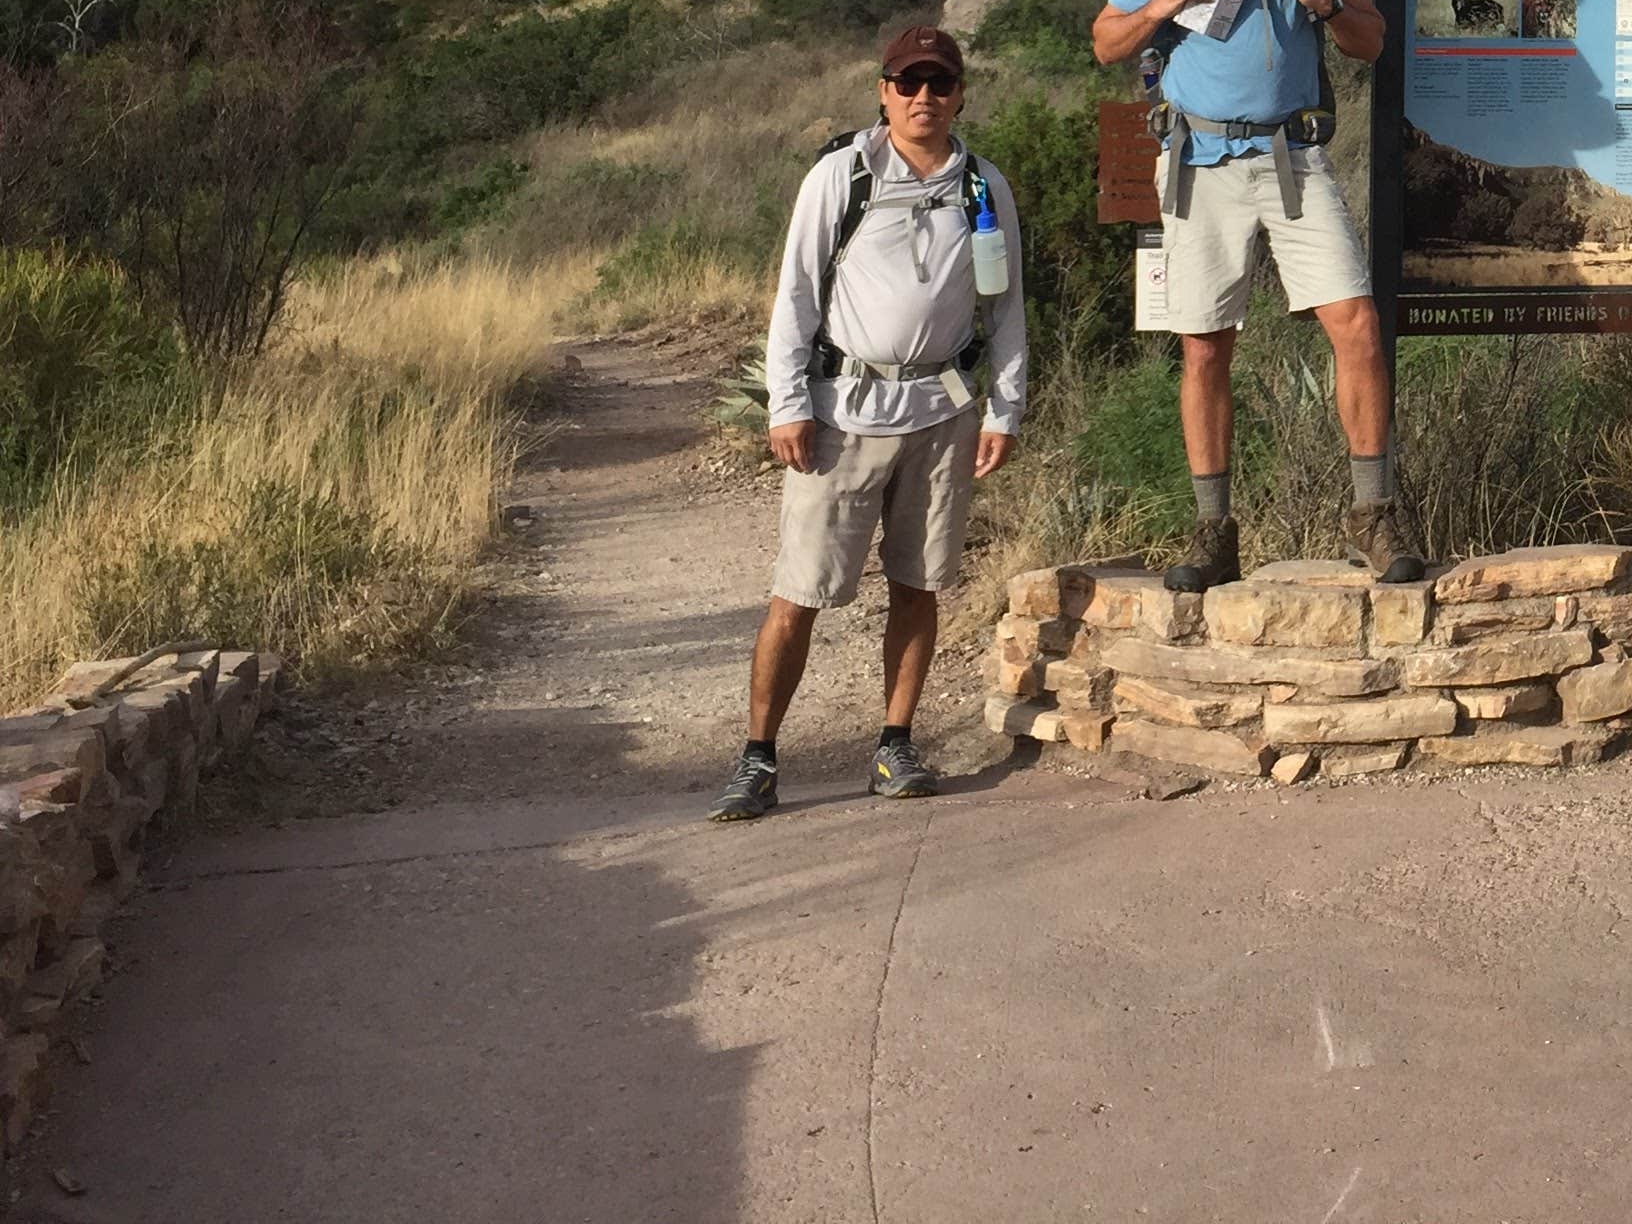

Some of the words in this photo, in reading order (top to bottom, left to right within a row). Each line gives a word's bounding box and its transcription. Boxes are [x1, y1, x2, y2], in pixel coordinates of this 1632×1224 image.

[1408, 308, 1494, 325] DONATED
[1504, 307, 1526, 323] BY
[1536, 306, 1608, 322] FRIENDS
